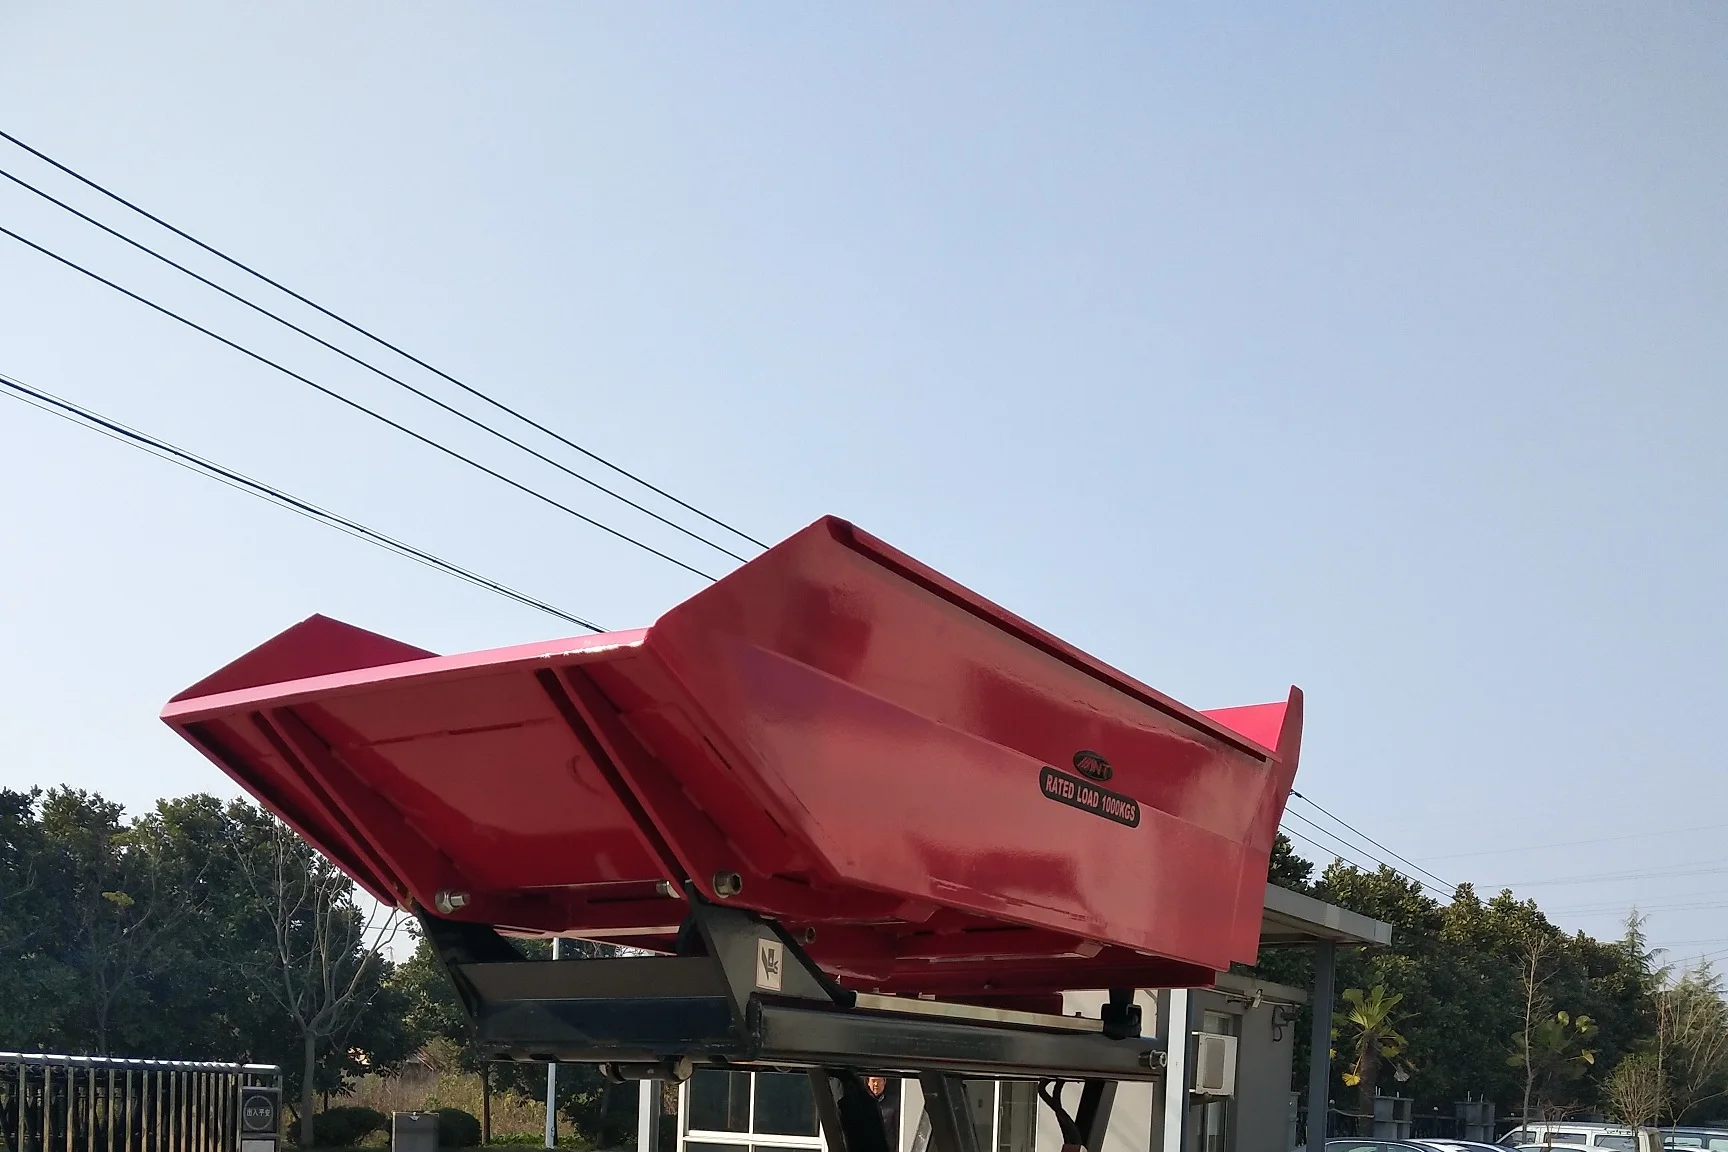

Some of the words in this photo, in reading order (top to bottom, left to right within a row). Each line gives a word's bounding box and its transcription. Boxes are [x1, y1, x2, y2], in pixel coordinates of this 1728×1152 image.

[1045, 774, 1075, 799] RATED
[1077, 785, 1099, 808] LOAD
[1102, 794, 1136, 821] 1000KGS
[246, 1108, 271, 1117] 出入平安
